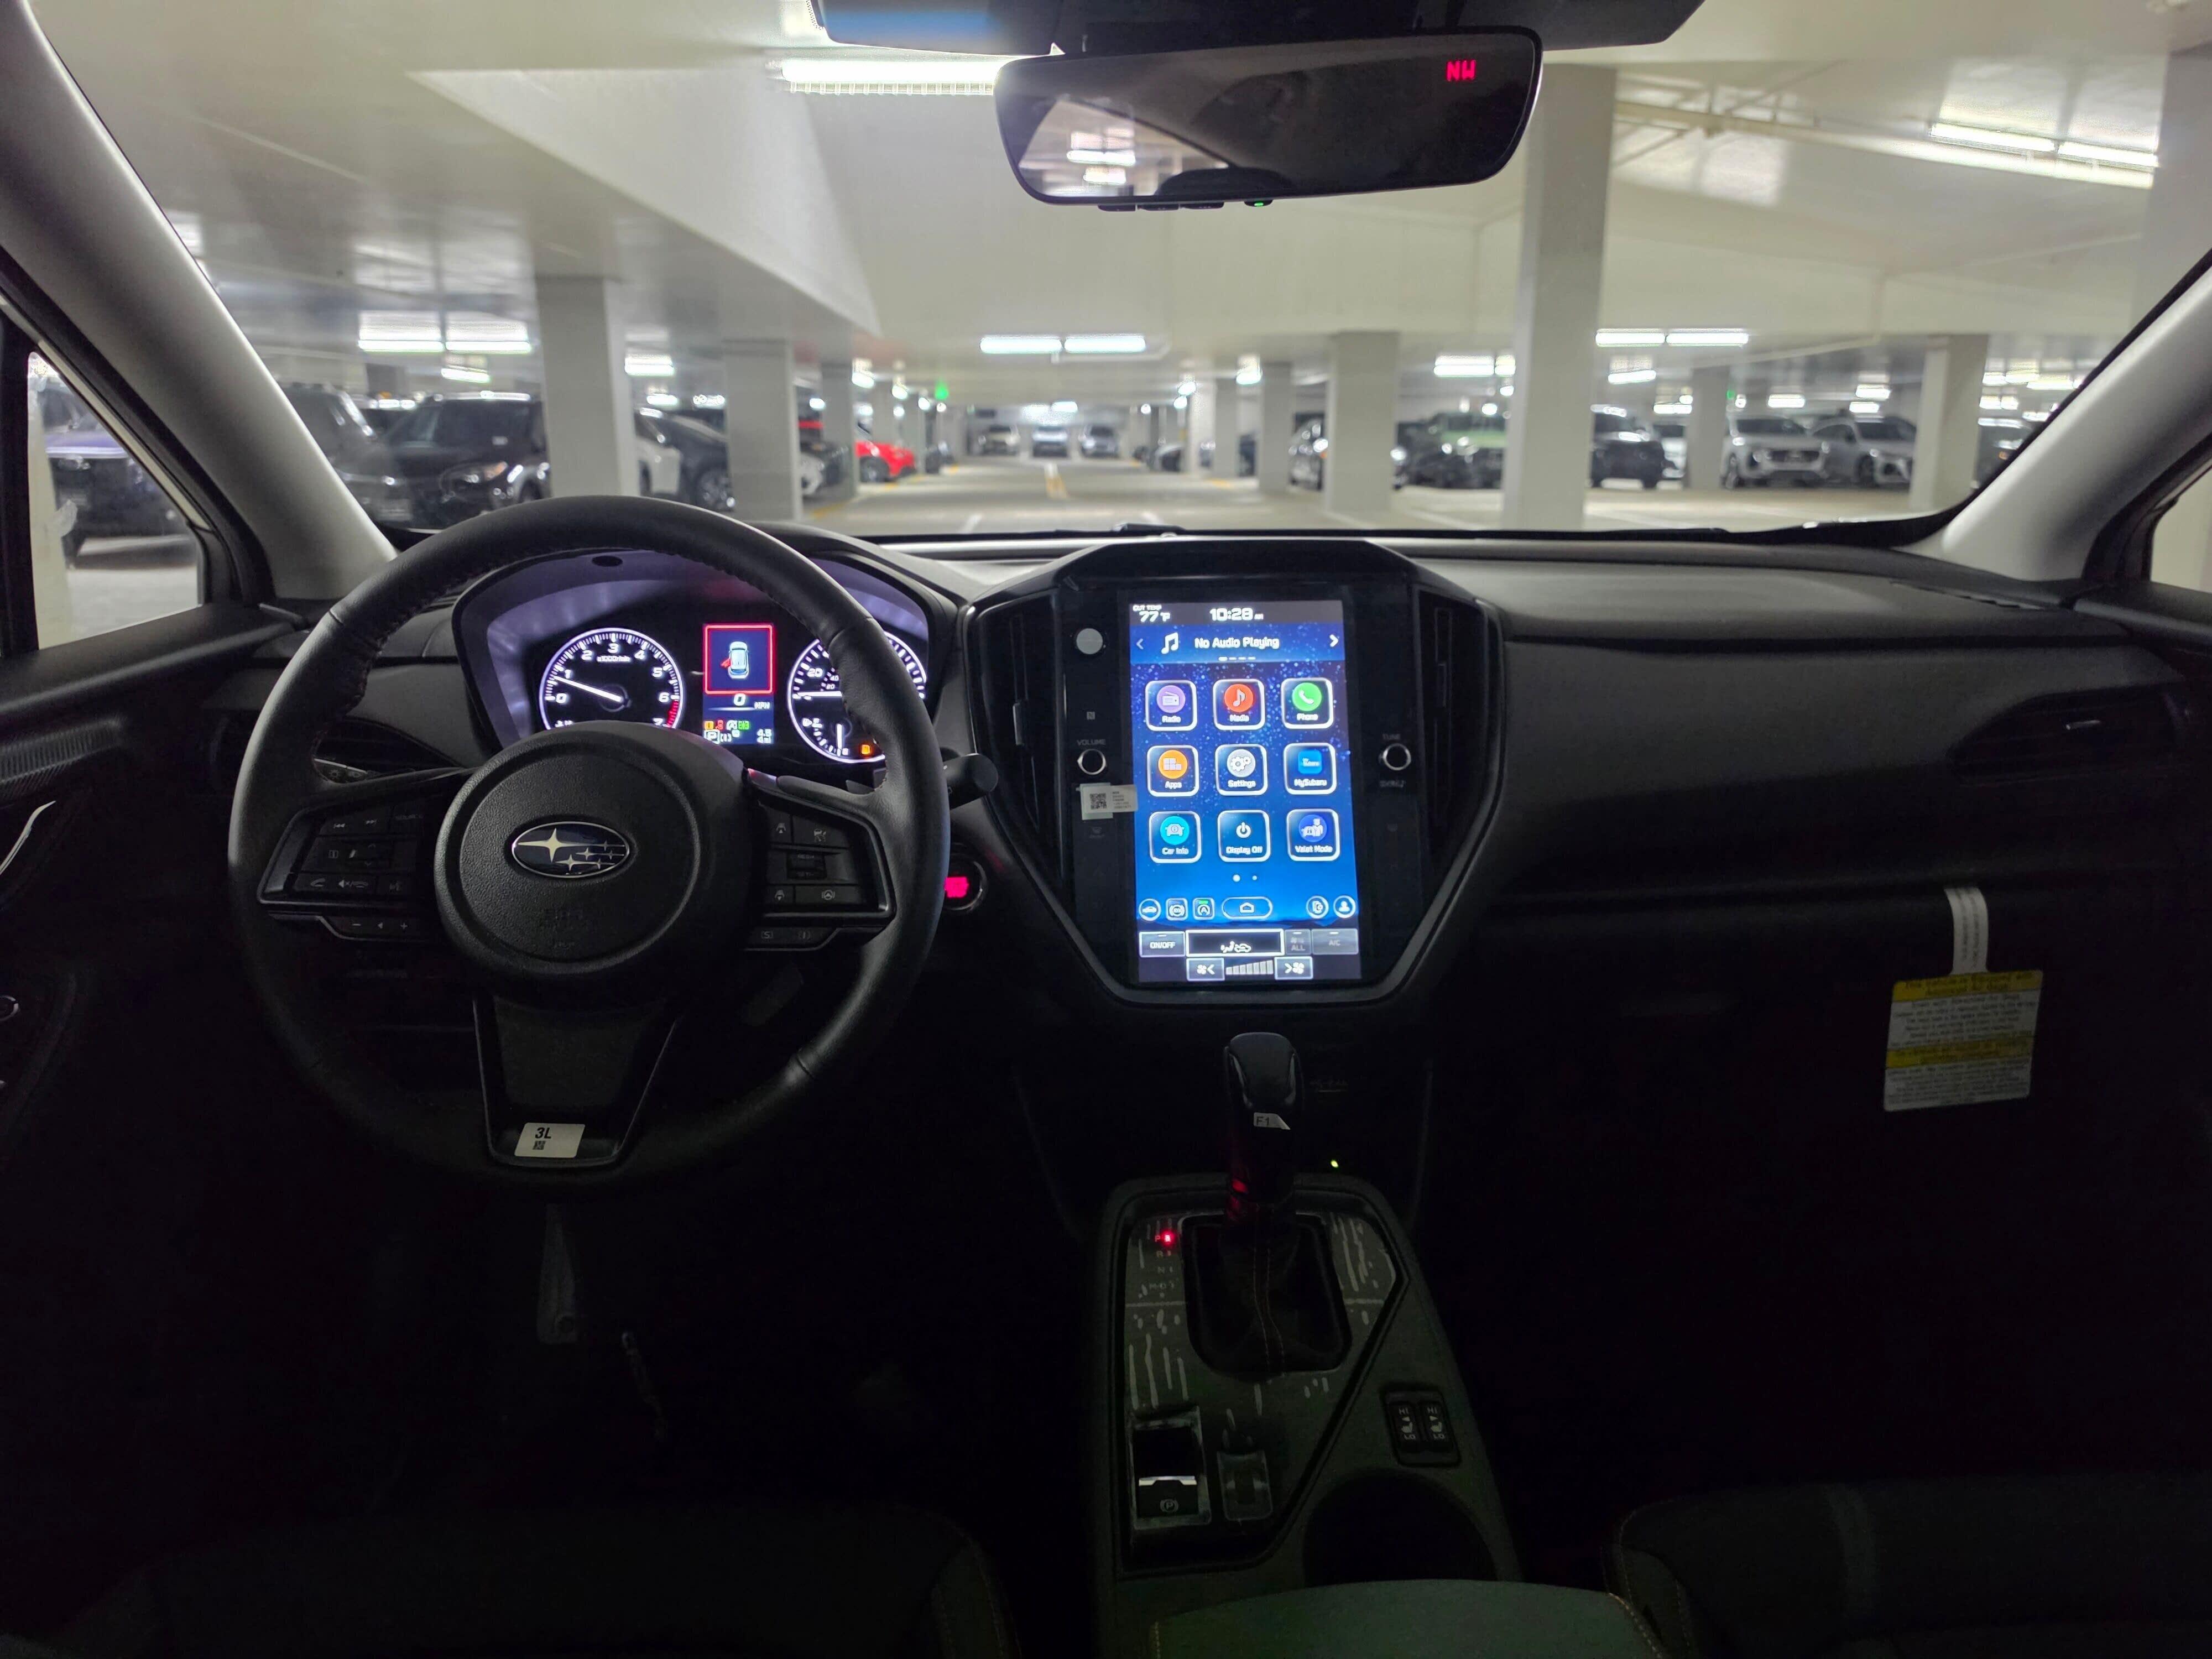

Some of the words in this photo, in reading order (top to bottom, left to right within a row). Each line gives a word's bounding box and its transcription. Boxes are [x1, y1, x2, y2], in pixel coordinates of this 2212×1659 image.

[1447, 59, 1475, 81] NW
[1139, 611, 1159, 622] 77
[1210, 608, 1254, 621] 10:28
[608, 643, 619, 653] 3
[1194, 638, 1210, 649] No
[1212, 637, 1240, 648] Audio
[1243, 636, 1280, 650] Playing
[582, 650, 593, 660] 2
[634, 650, 645, 660] 4
[563, 670, 571, 679] 1
[653, 667, 662, 677] 5
[807, 667, 823, 677] 20
[556, 693, 567, 704] 0
[659, 692, 670, 702] 6
[733, 693, 746, 706] 0
[1162, 715, 1181, 723] Radio
[1229, 714, 1249, 722] Media
[1297, 713, 1318, 721] Phone
[1165, 780, 1182, 790] Apps
[1228, 780, 1256, 789] Settings
[1175, 847, 1189, 855] Info
[1225, 846, 1251, 855] Display
[1251, 846, 1263, 854] Off
[1295, 845, 1313, 853] Valet
[1313, 845, 1333, 853] Mode
[1150, 941, 1176, 950] ON/OFF
[1256, 1117, 1270, 1126] F1
[535, 1127, 552, 1139] 3L
